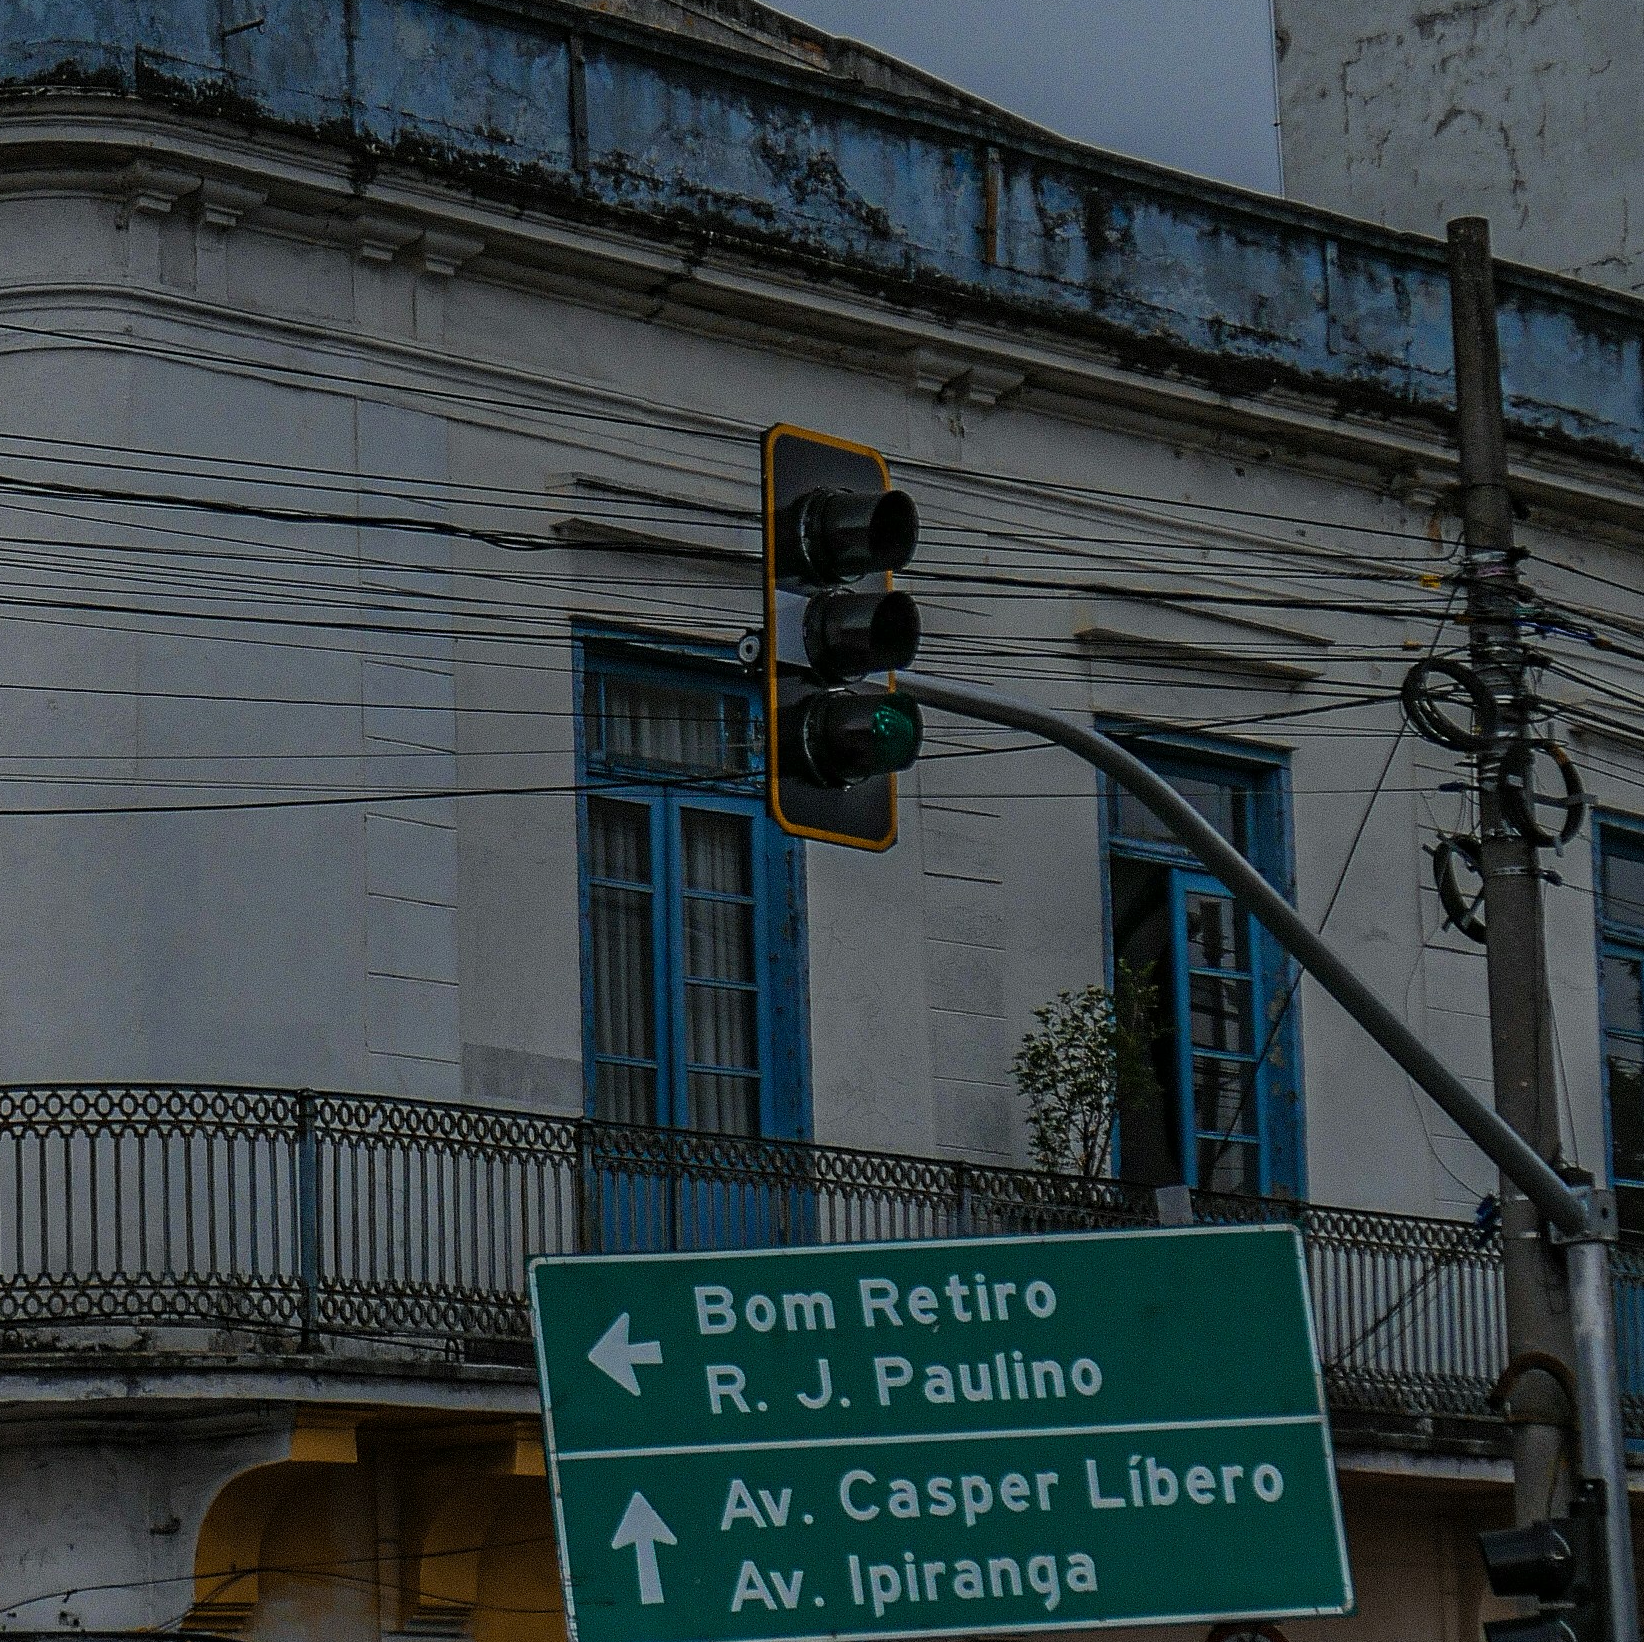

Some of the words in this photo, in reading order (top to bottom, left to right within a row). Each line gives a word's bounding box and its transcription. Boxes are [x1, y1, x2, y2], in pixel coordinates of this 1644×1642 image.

[694, 1285, 836, 1335] Bom
[859, 1274, 1057, 1327] Retiro
[705, 1364, 768, 1414] R.
[796, 1358, 852, 1410] J.
[873, 1350, 1104, 1407] Paulino
[720, 1478, 815, 1531] Av.
[839, 1469, 1059, 1528] Casper
[1085, 1453, 1285, 1510] Líbero
[731, 1560, 826, 1613] Av.
[848, 1551, 1098, 1617] Ipiranga
